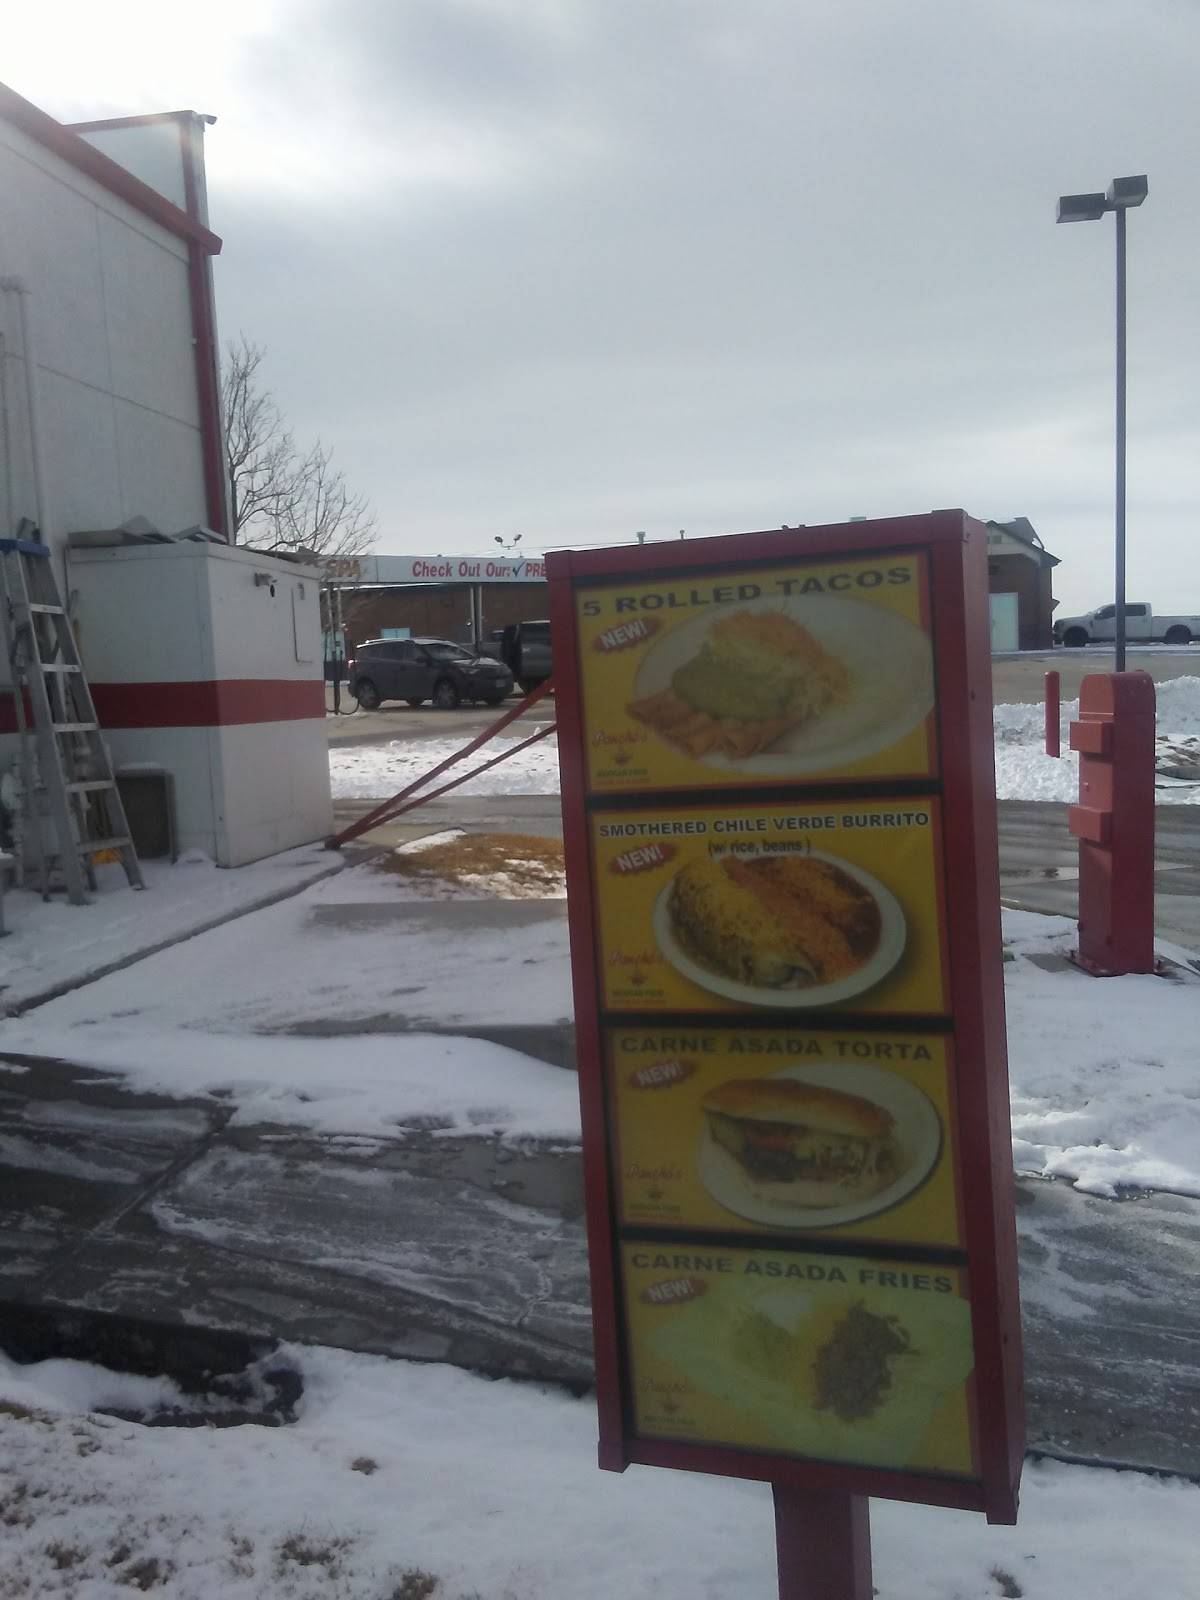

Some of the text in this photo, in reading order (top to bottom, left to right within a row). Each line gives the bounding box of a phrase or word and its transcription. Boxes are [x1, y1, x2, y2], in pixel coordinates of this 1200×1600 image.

[412, 560, 452, 577] Check
[459, 561, 481, 577] Out
[583, 567, 912, 617] 5 ROLLED TACOS
[600, 619, 647, 650] NEW!
[599, 812, 929, 838] SMOTHERED CHILE VERDE BURRITO
[616, 845, 664, 872] NEW!
[730, 840, 760, 855] rice,
[620, 1036, 933, 1061] CARNE ASADA TORTA
[637, 1061, 684, 1086] NEW!
[631, 1253, 954, 1293] CARNE ASADA FRIES
[649, 1279, 695, 1303] NEW!
